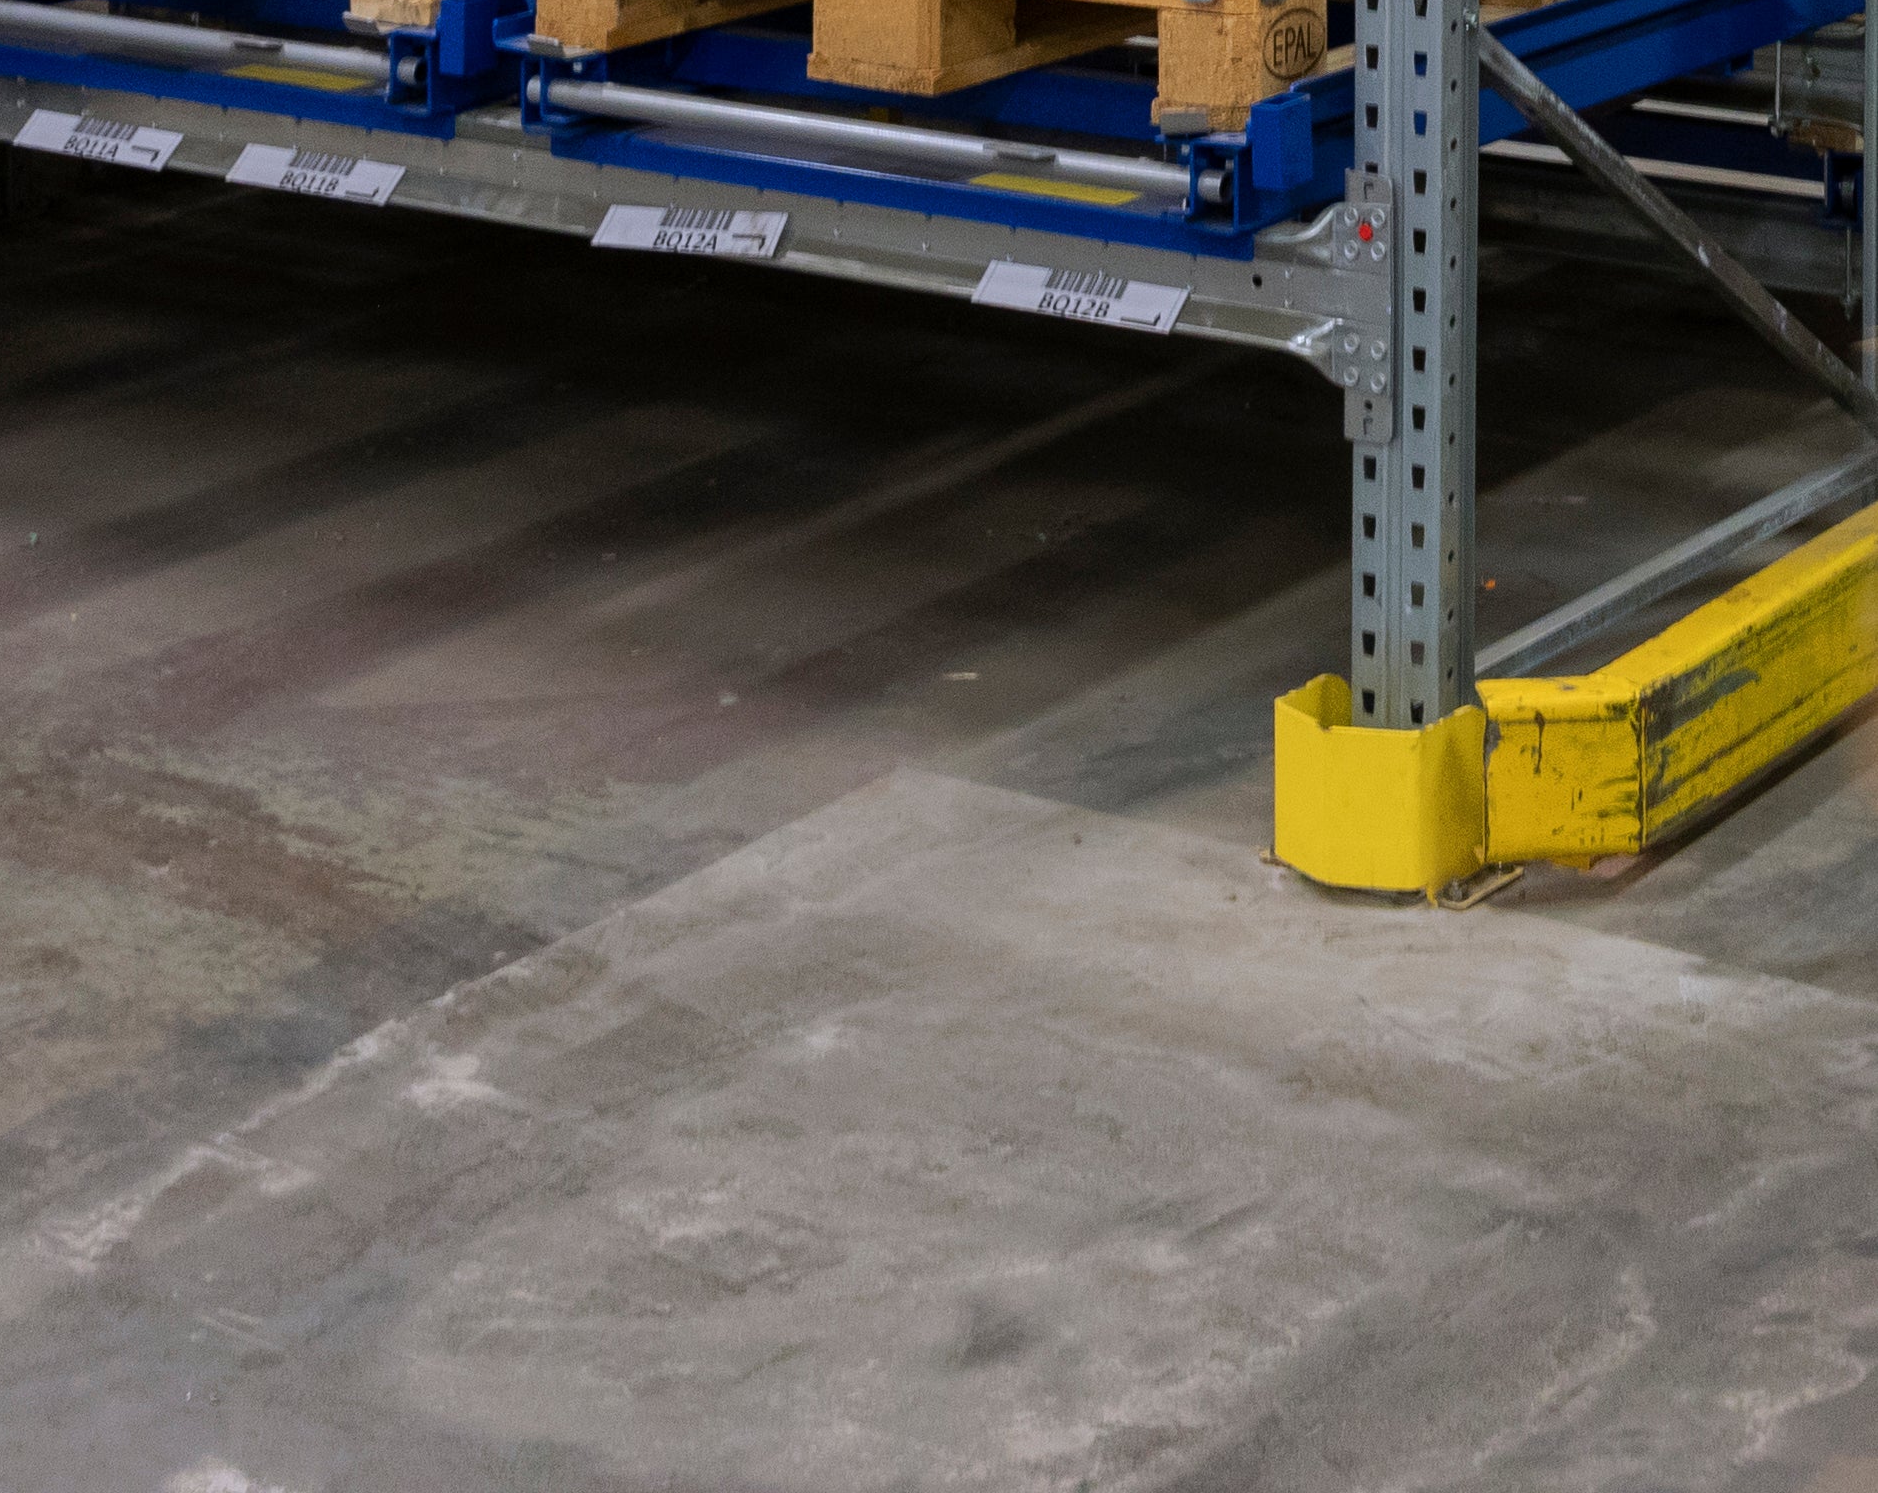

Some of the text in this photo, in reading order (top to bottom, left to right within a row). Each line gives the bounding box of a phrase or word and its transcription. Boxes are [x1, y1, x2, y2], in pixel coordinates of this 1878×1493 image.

[1273, 20, 1317, 68] EPAL
[63, 134, 120, 161] BQ11A
[279, 170, 338, 195] BQ11B
[652, 228, 718, 253] BQ12A
[1037, 292, 1111, 323] BQ12B
